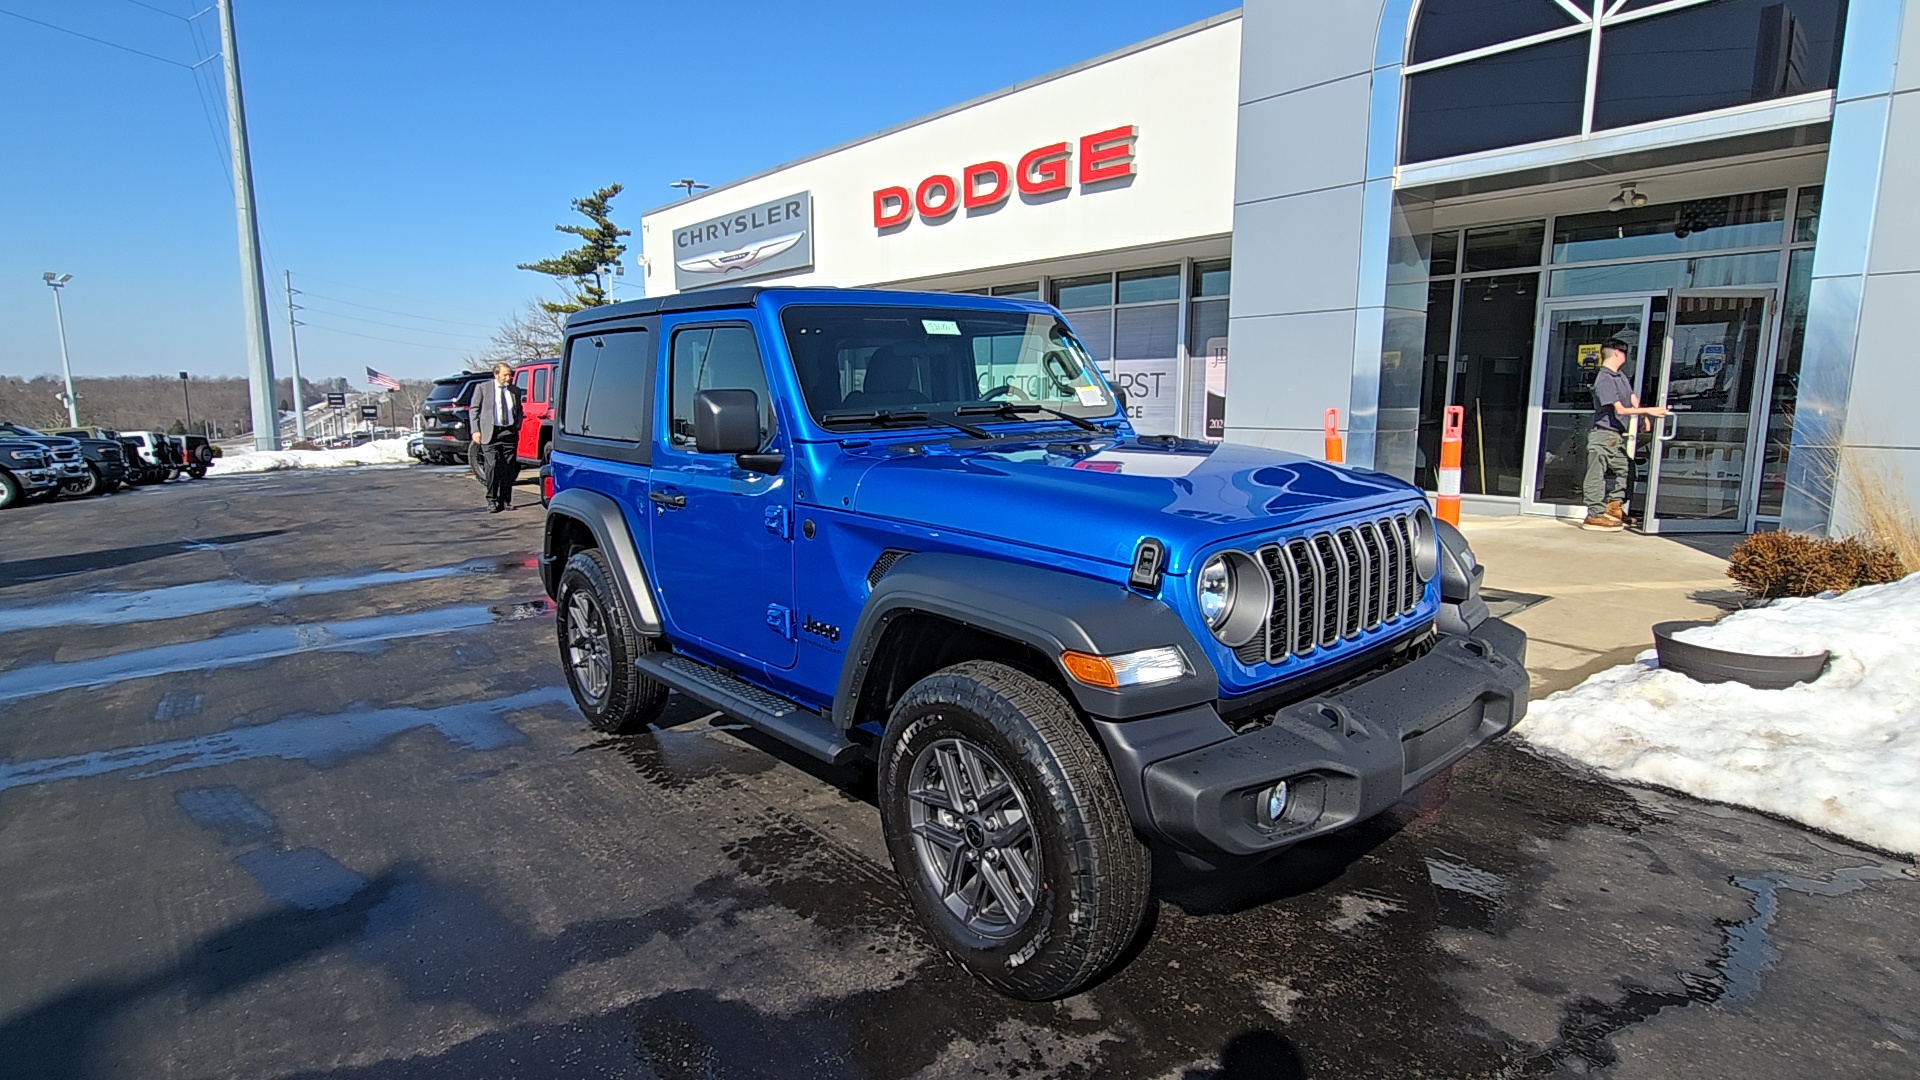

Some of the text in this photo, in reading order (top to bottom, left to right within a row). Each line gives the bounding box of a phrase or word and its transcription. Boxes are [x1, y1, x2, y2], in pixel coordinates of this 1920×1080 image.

[873, 125, 1137, 228] DODGE
[677, 201, 801, 248] CHRYSLER
[978, 371, 1074, 397] CUSTOME
[1099, 370, 1167, 398] RST
[801, 614, 840, 644] Jeep
